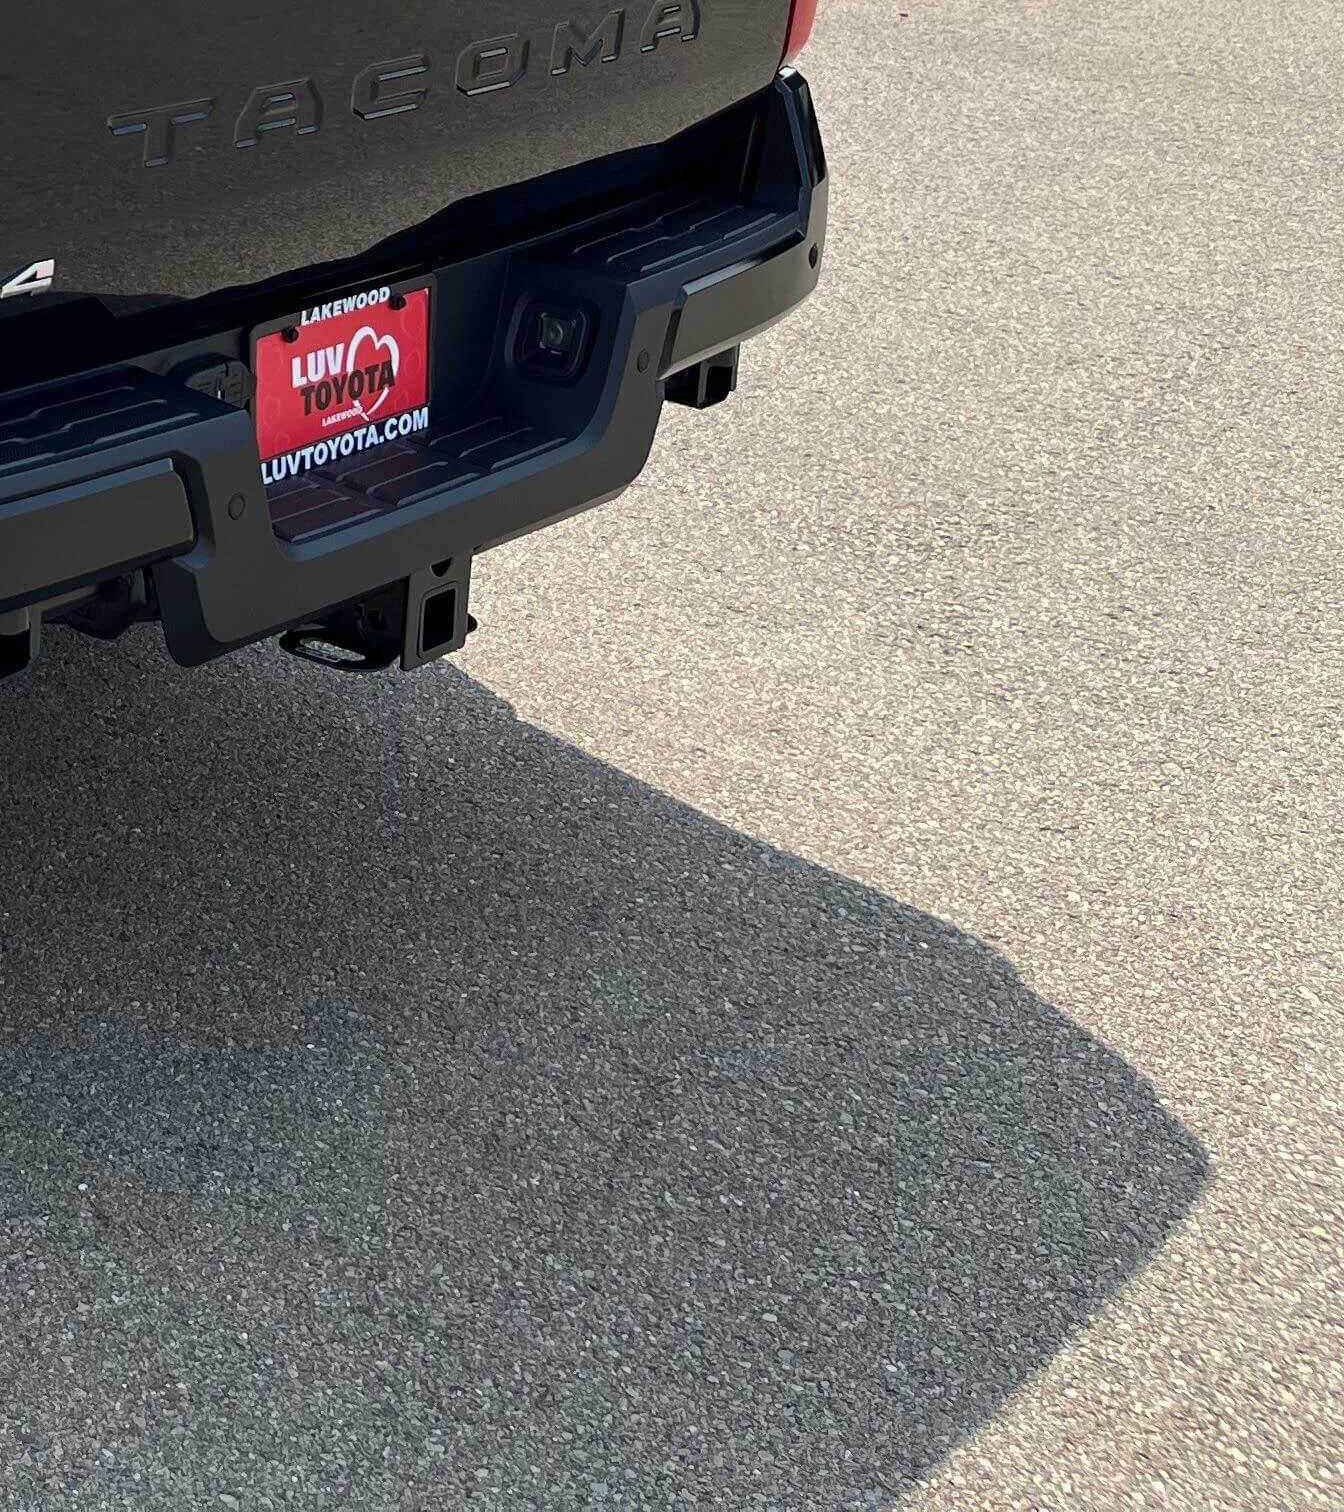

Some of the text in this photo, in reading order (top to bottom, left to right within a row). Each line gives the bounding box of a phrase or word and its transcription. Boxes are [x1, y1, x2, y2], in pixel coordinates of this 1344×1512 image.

[300, 286, 392, 326] LAKEWOOD
[291, 342, 346, 388] LUV
[300, 359, 396, 416] TOYOTA
[261, 406, 430, 485] LUVTOYOTA.COM
